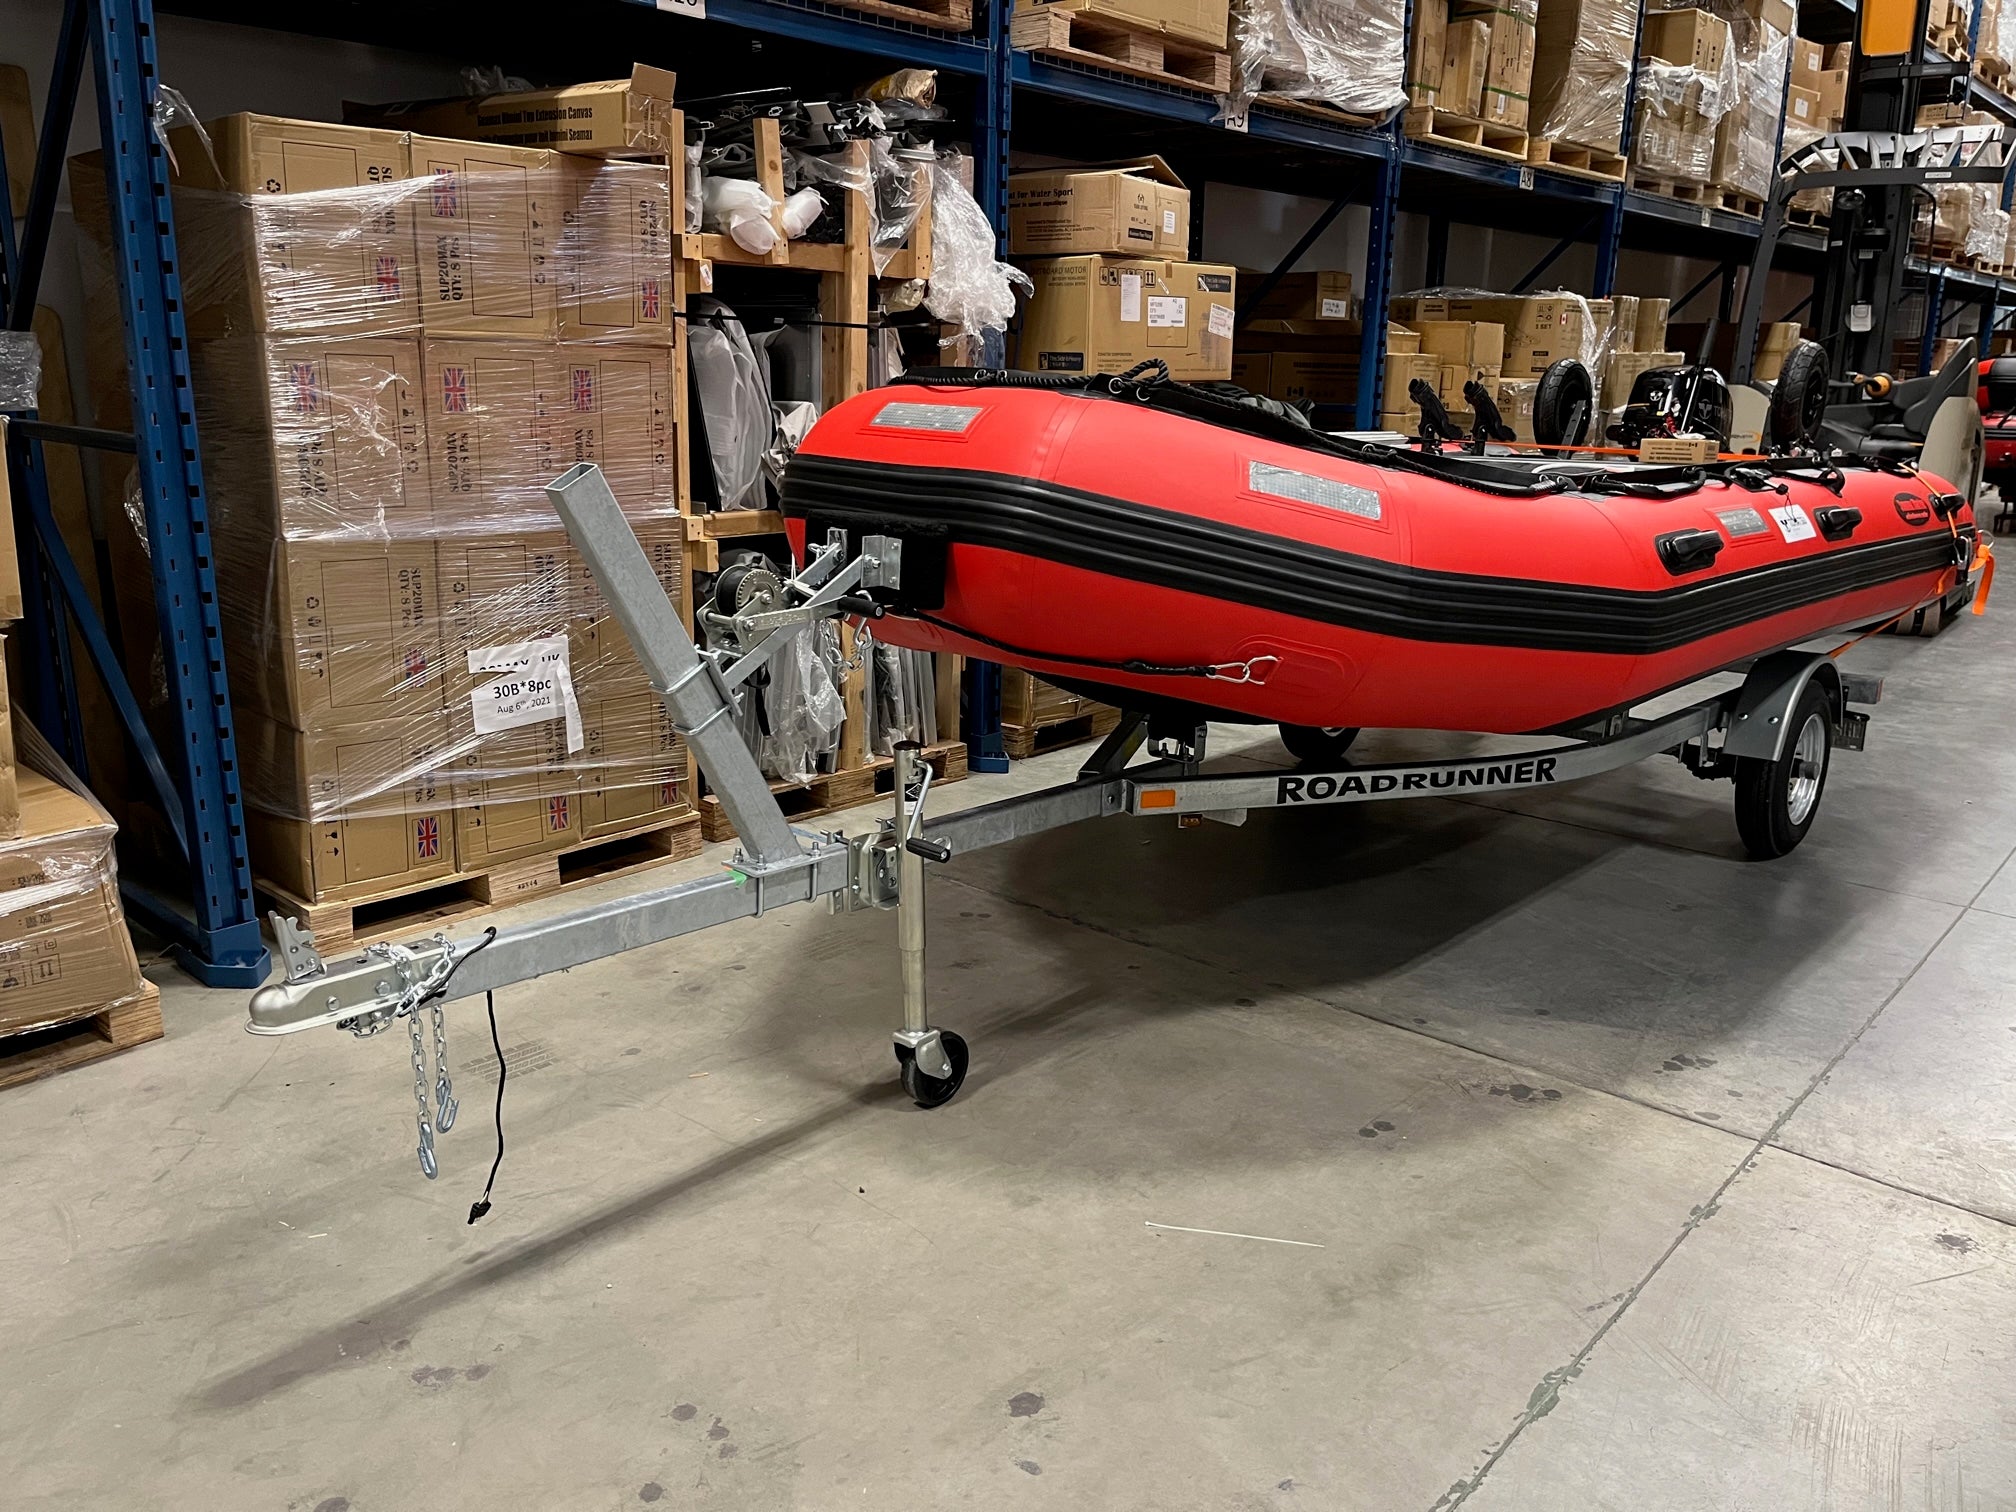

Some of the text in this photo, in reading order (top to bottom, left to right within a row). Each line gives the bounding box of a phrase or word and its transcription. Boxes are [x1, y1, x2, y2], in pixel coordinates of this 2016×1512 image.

[535, 107, 567, 121] Extension
[568, 106, 593, 120] Canvas
[568, 128, 593, 141] Seamax
[1016, 190, 1028, 199] for
[1029, 189, 1051, 199] Water
[1053, 187, 1073, 198] Sport
[437, 234, 451, 301] SUP20MAX
[450, 262, 461, 271] 8
[452, 274, 464, 301] QTY:
[312, 458, 324, 467] 8
[446, 432, 459, 493] SUP20MAX
[585, 451, 595, 459] 8
[398, 569, 411, 594] QTY:
[400, 597, 411, 605] 8
[411, 567, 424, 627] SUP20MAX
[497, 703, 514, 714] Aug
[531, 695, 551, 708] 2021
[1276, 757, 1557, 804] ROADRUNNER
